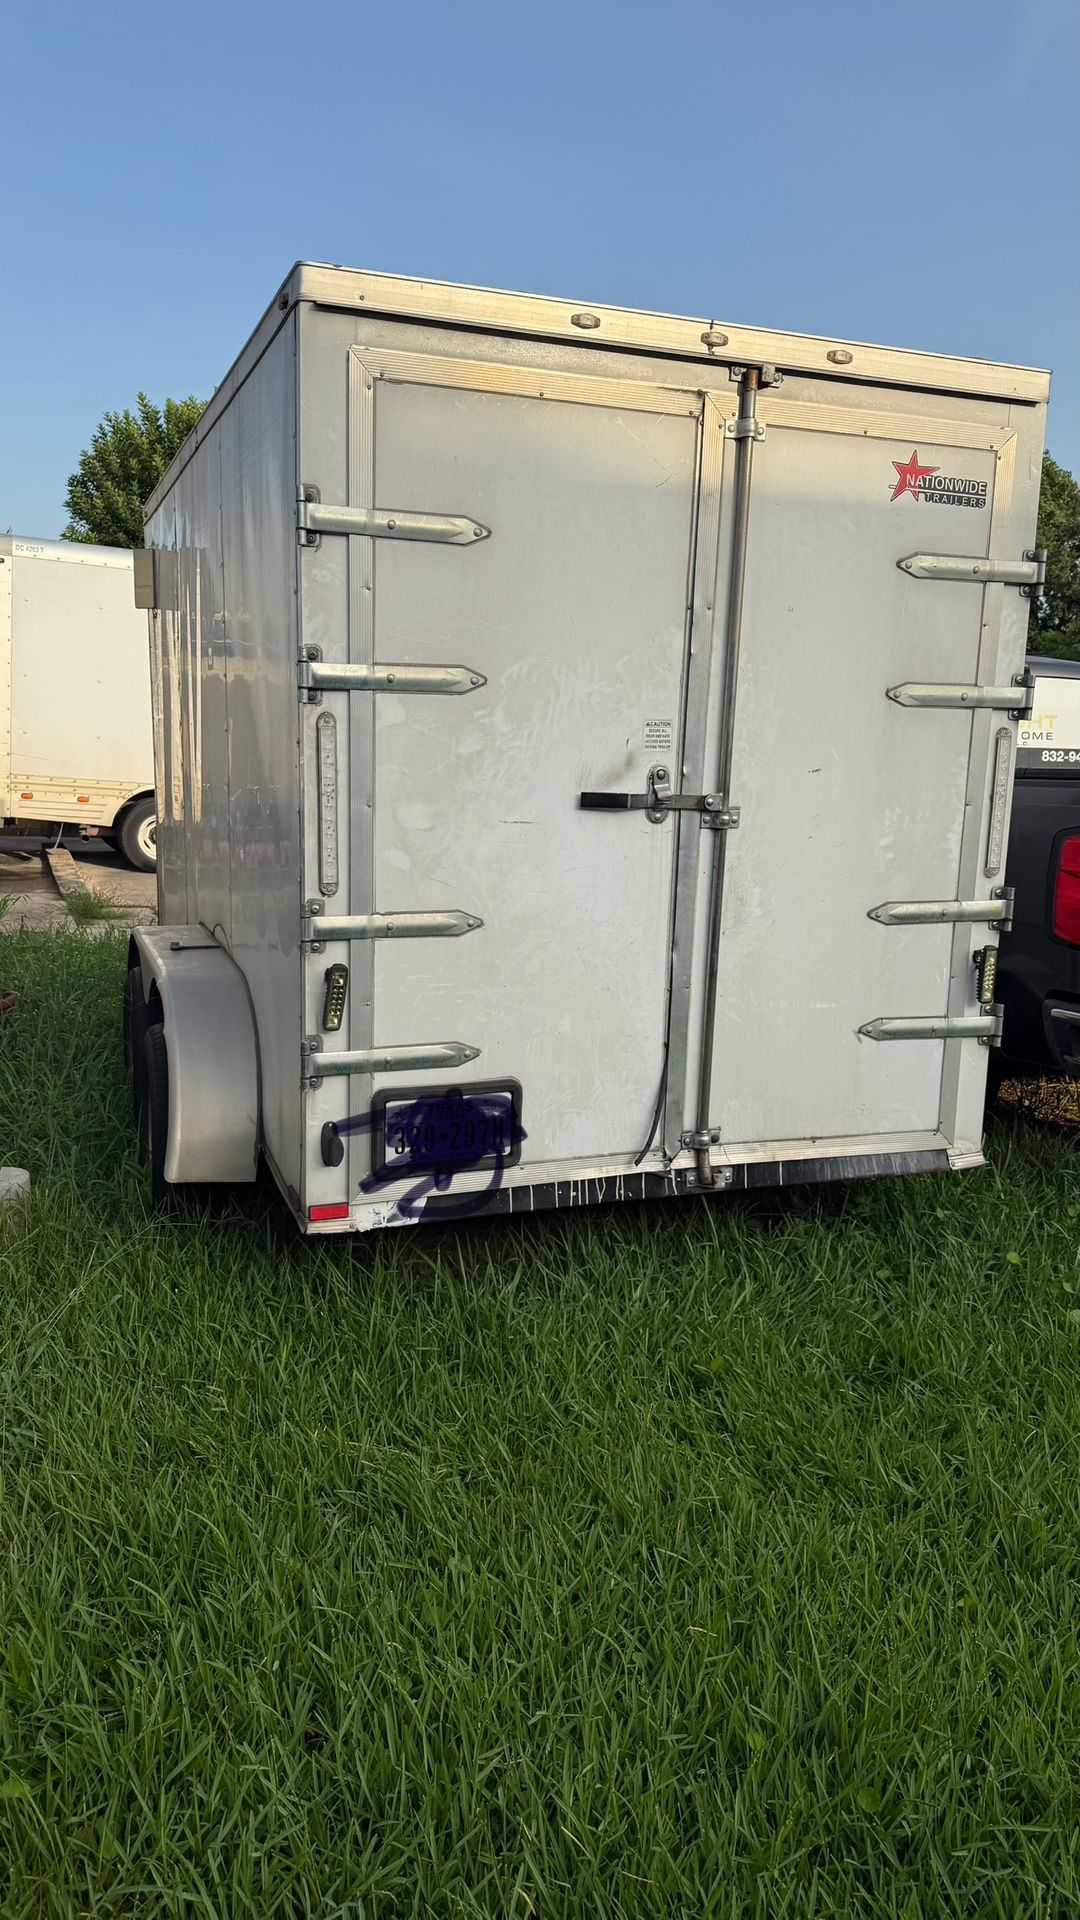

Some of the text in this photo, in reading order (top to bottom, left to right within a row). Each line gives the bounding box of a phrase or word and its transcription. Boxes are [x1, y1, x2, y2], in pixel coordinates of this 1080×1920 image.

[906, 473, 987, 494] NATIONWIDE
[925, 492, 986, 508] TRAILERS
[427, 1101, 475, 1115] TEXAS
